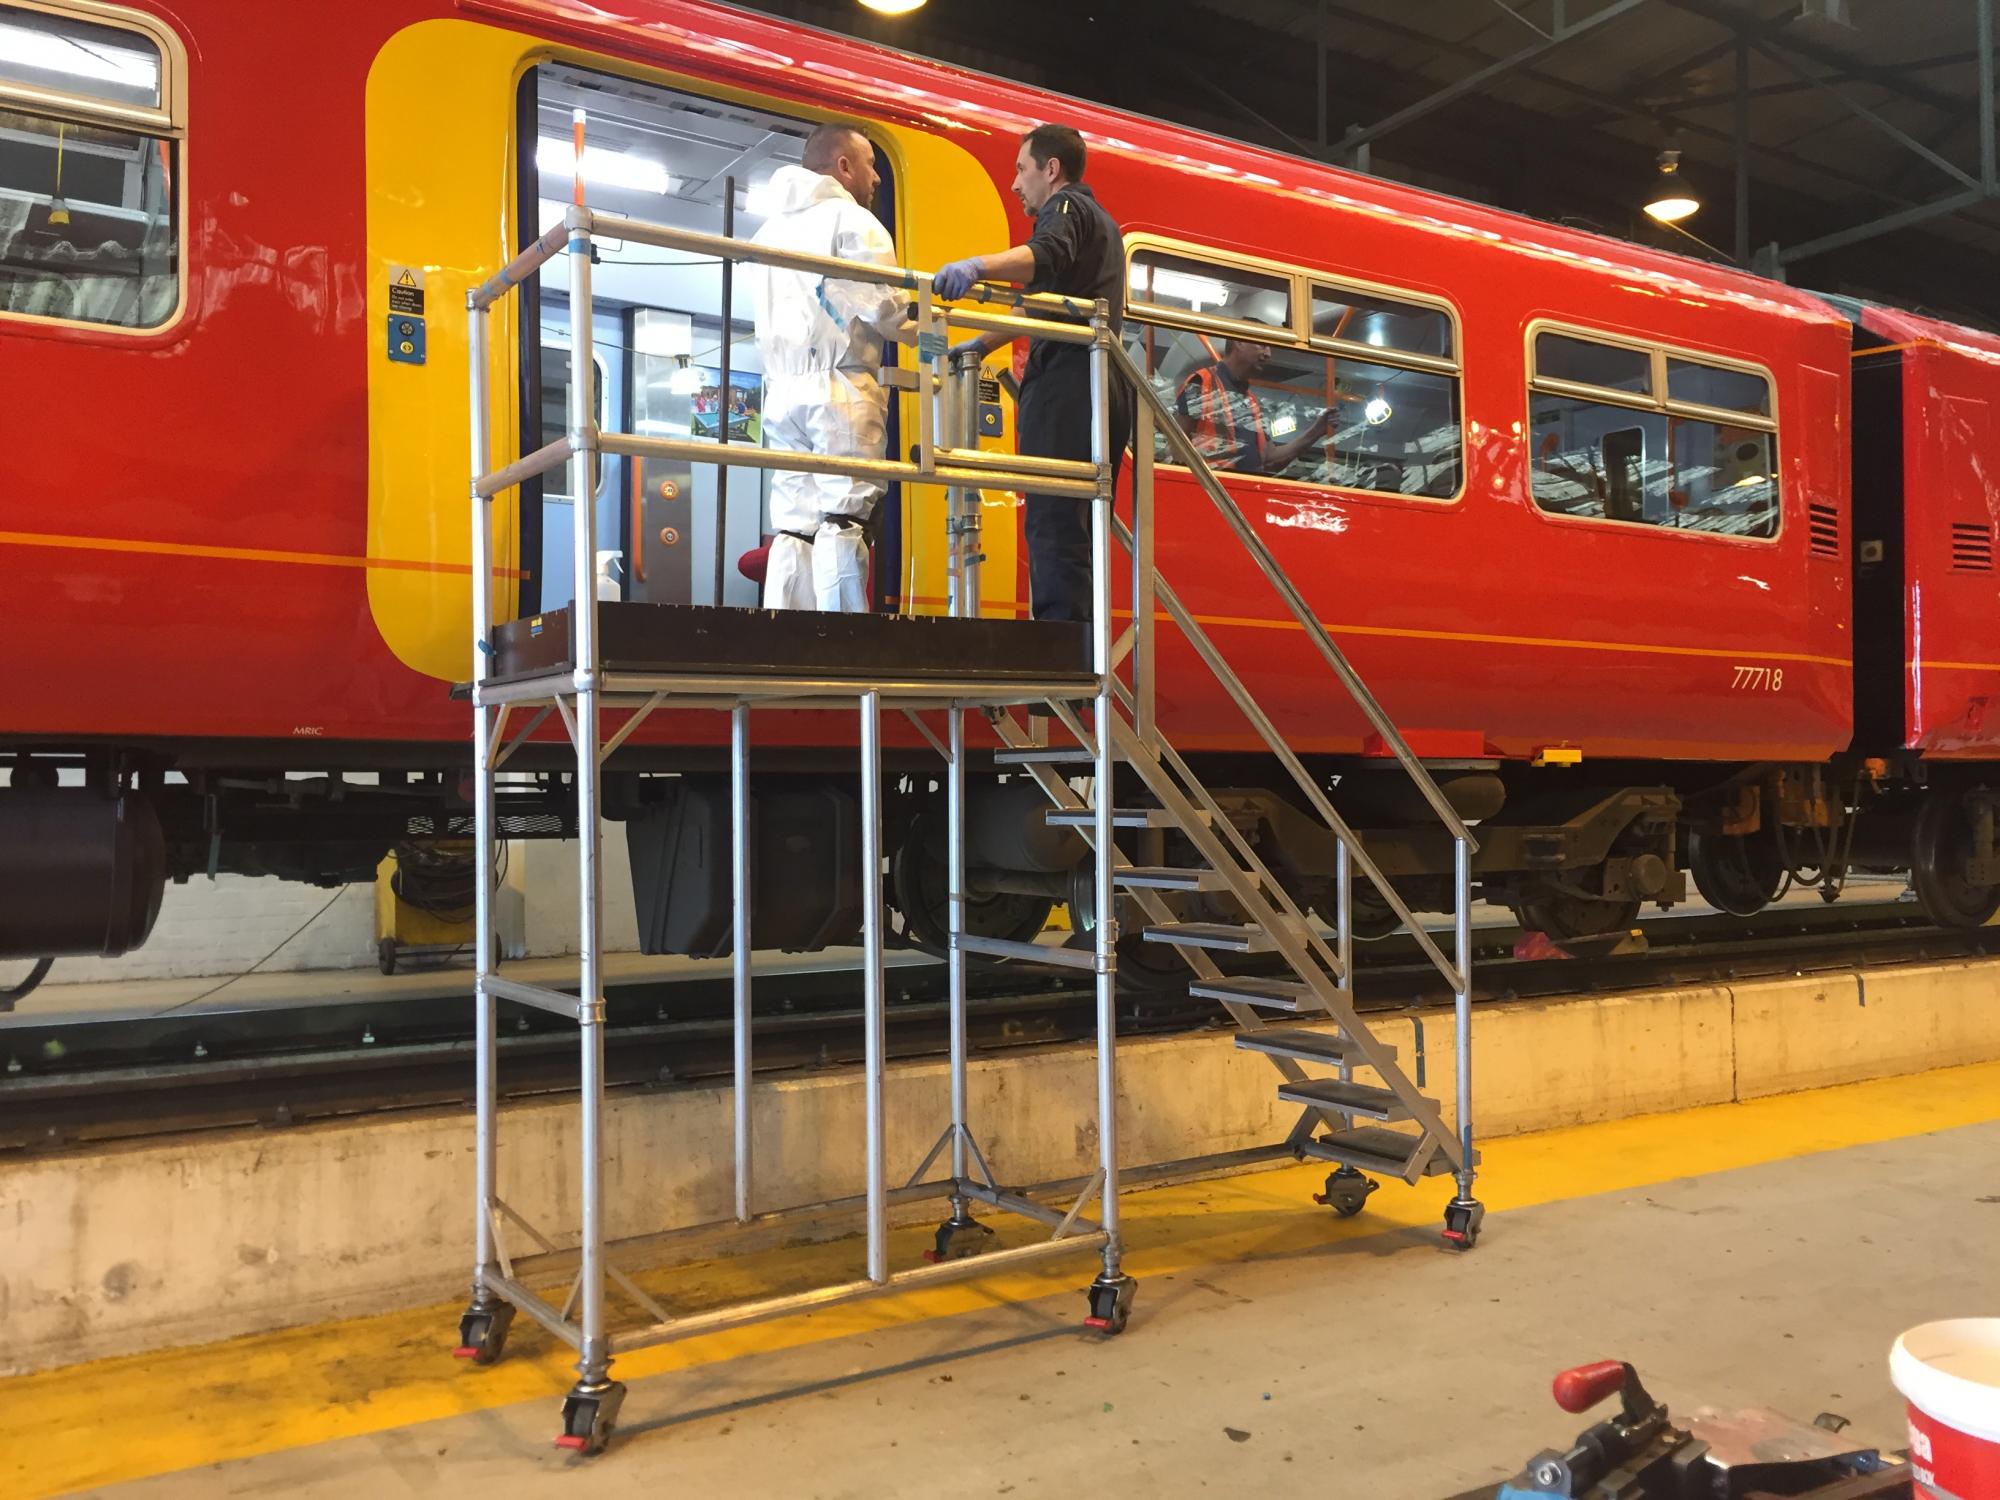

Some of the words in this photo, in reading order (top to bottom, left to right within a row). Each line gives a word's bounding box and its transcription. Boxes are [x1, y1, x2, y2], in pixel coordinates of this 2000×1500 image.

[391, 287, 415, 297] Caution
[1731, 665, 1783, 692] 77718
[292, 726, 324, 736] MRIC
